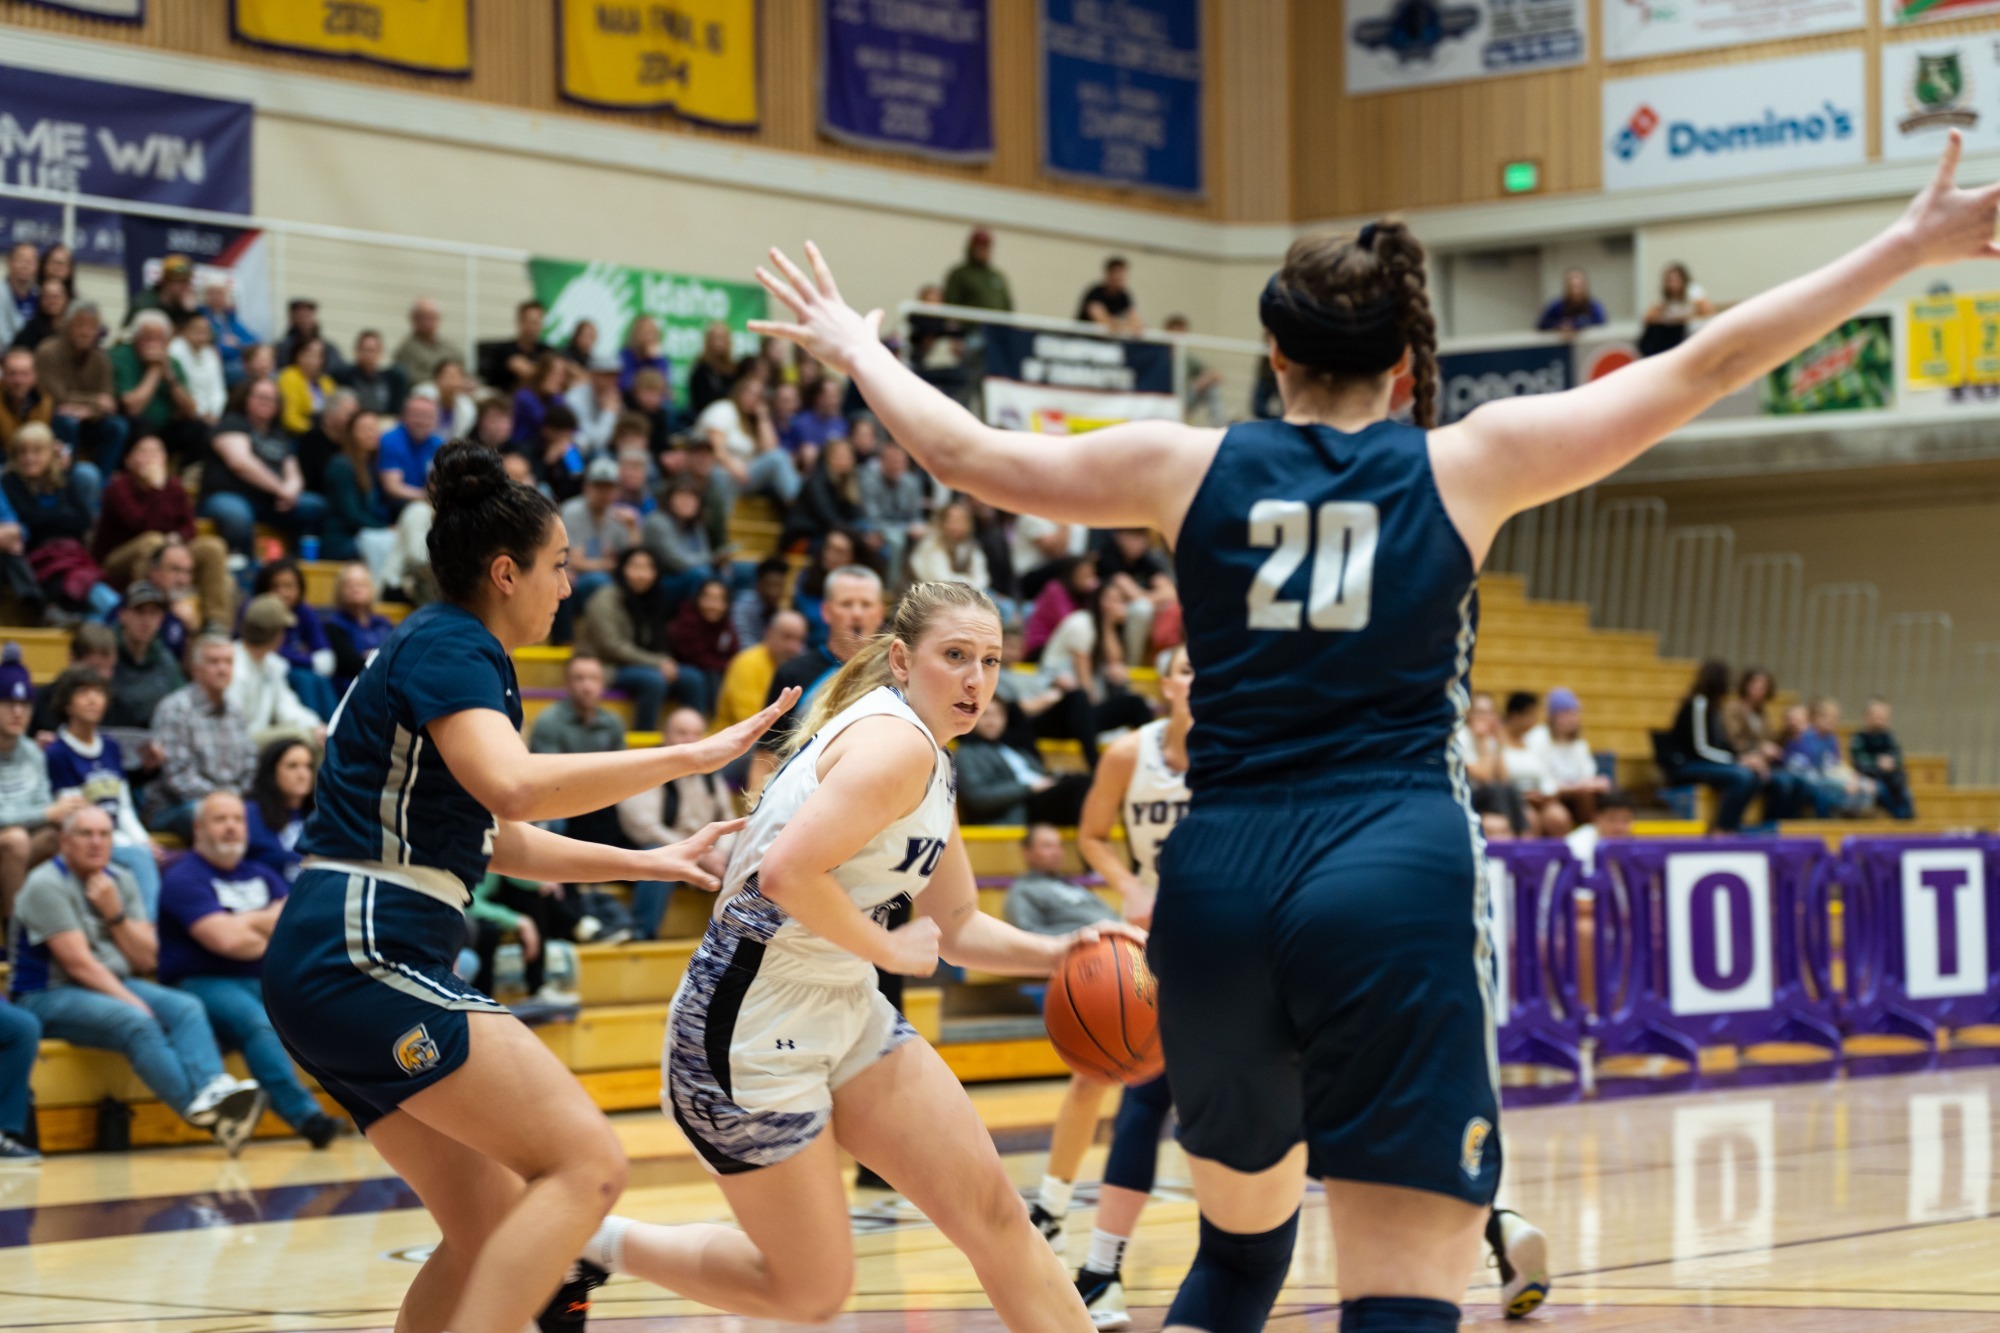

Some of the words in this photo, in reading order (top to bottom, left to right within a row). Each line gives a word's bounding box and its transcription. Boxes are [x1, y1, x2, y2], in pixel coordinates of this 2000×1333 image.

[97, 126, 206, 183] WIN
[1668, 102, 1854, 158] Domino's
[641, 271, 731, 320] Idaho
[1450, 358, 1566, 420] pepsi
[1246, 498, 1380, 632] 20
[1689, 871, 1755, 992] O
[1918, 868, 1969, 977] T
